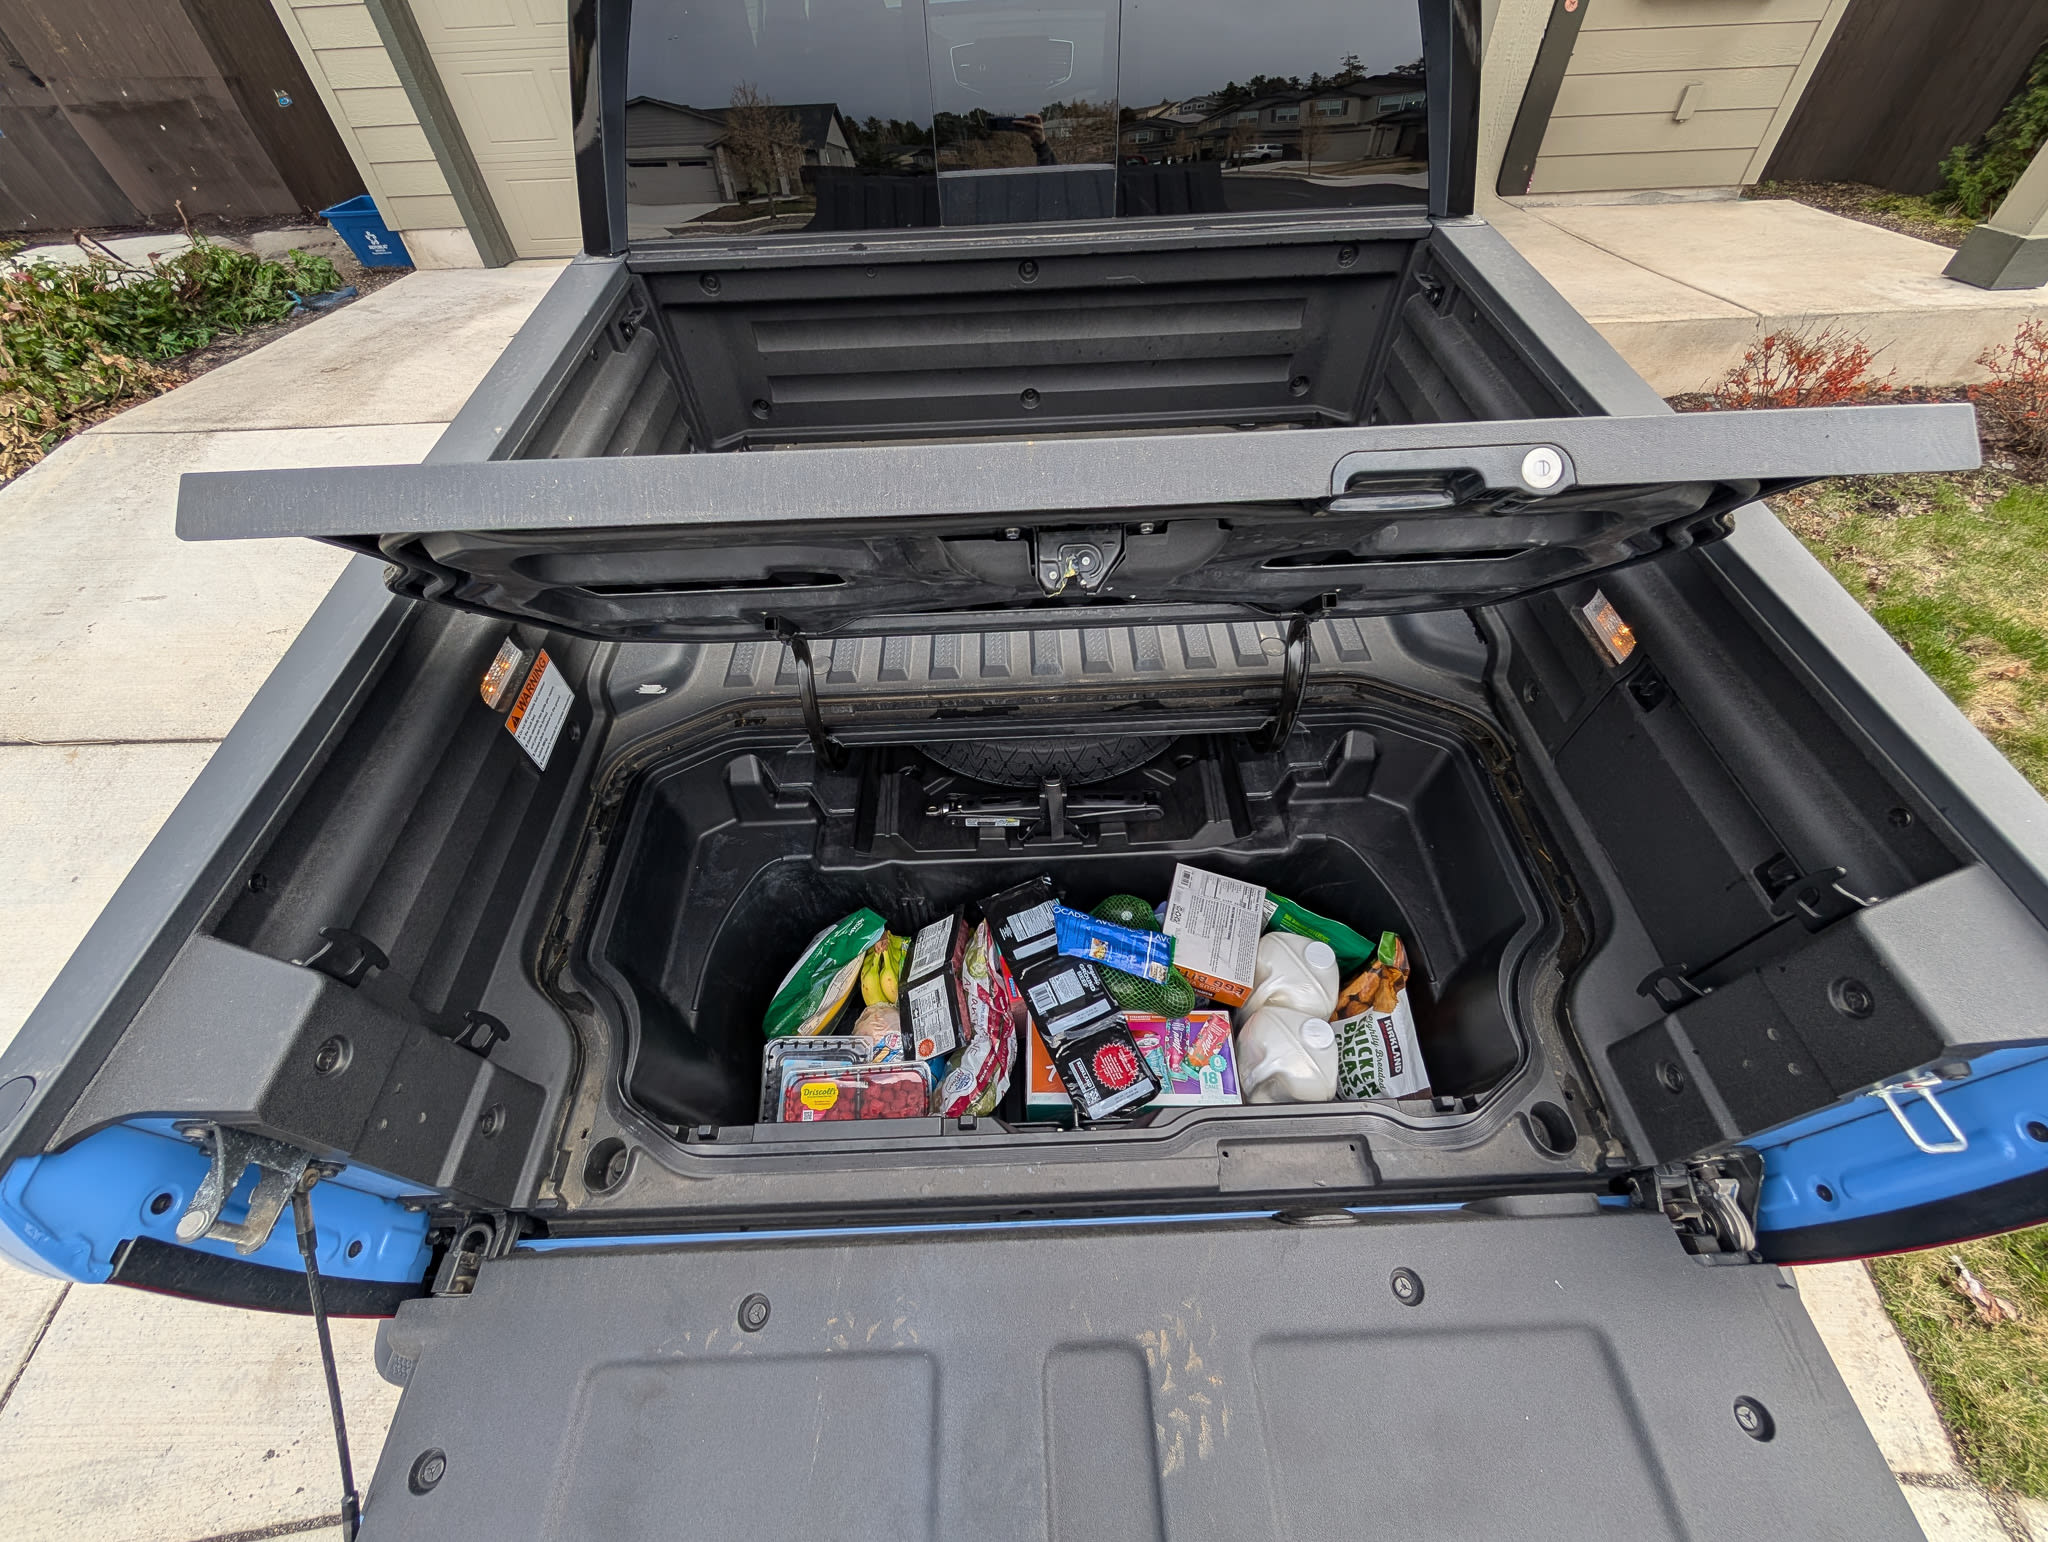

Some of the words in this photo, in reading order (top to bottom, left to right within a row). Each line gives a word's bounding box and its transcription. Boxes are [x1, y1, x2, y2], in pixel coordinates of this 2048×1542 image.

[516, 655, 546, 713] WARNING
[1053, 905, 1089, 920] OCADO
[1078, 962, 1095, 992] GROUND
[1175, 967, 1207, 983] BIT
[1198, 982, 1220, 992] SOUS
[1211, 980, 1244, 994] EGG
[1342, 1021, 1371, 1097] BREAST
[1358, 1015, 1380, 1096] CHICKEN
[1383, 1018, 1402, 1073] KIRKLAND
[1075, 1060, 1092, 1087] KIRKLAND
[1202, 1071, 1218, 1084] 18
[1374, 1047, 1385, 1089] Breaded
